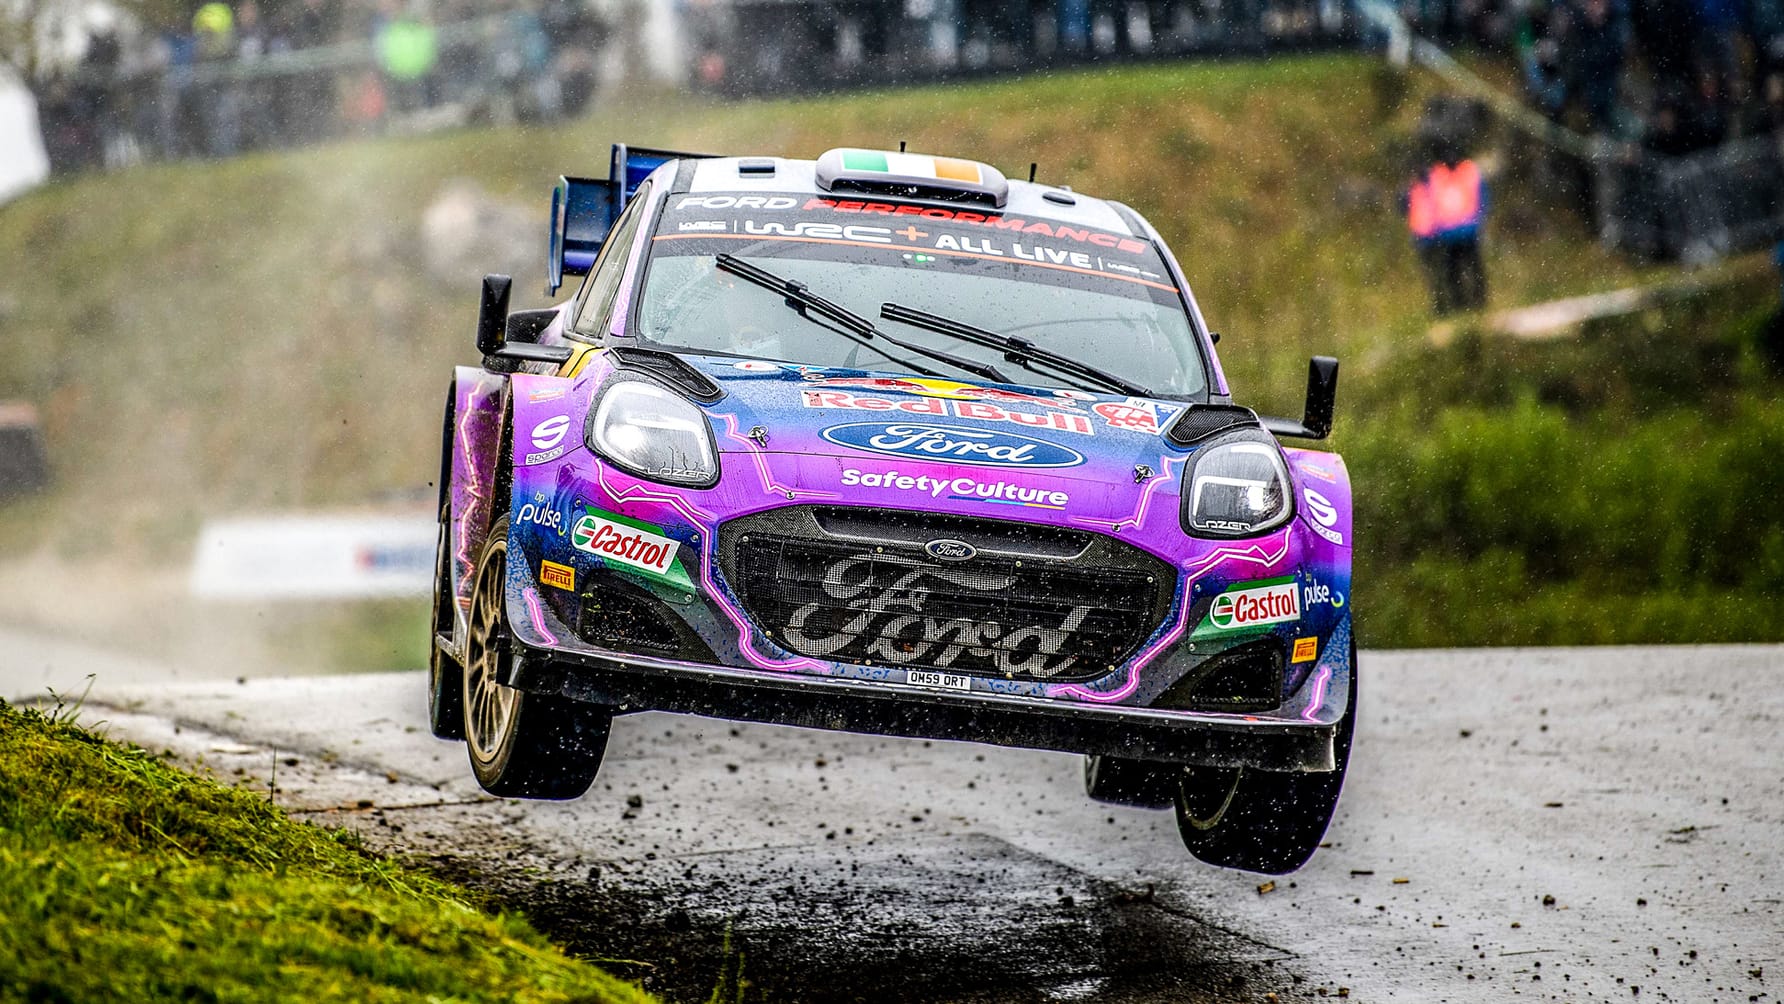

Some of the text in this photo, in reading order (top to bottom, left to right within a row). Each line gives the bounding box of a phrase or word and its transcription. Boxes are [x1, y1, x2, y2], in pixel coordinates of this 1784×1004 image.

[675, 195, 1146, 253] FORD PERFORMANCE
[934, 234, 1004, 256] ALL
[1013, 243, 1092, 269] LIVE
[808, 391, 945, 416] Red
[958, 403, 1090, 434] Bull
[868, 424, 1037, 464] Ford
[840, 468, 1070, 507] SafetyCulture
[516, 503, 561, 529] pulse
[591, 524, 671, 569] Castrol
[936, 543, 966, 557] Ford
[543, 565, 572, 586] PIRELLI
[1234, 589, 1297, 620] Castrol
[1304, 578, 1330, 612] pulse
[783, 555, 1090, 677] Ford
[943, 675, 966, 688] ORT
